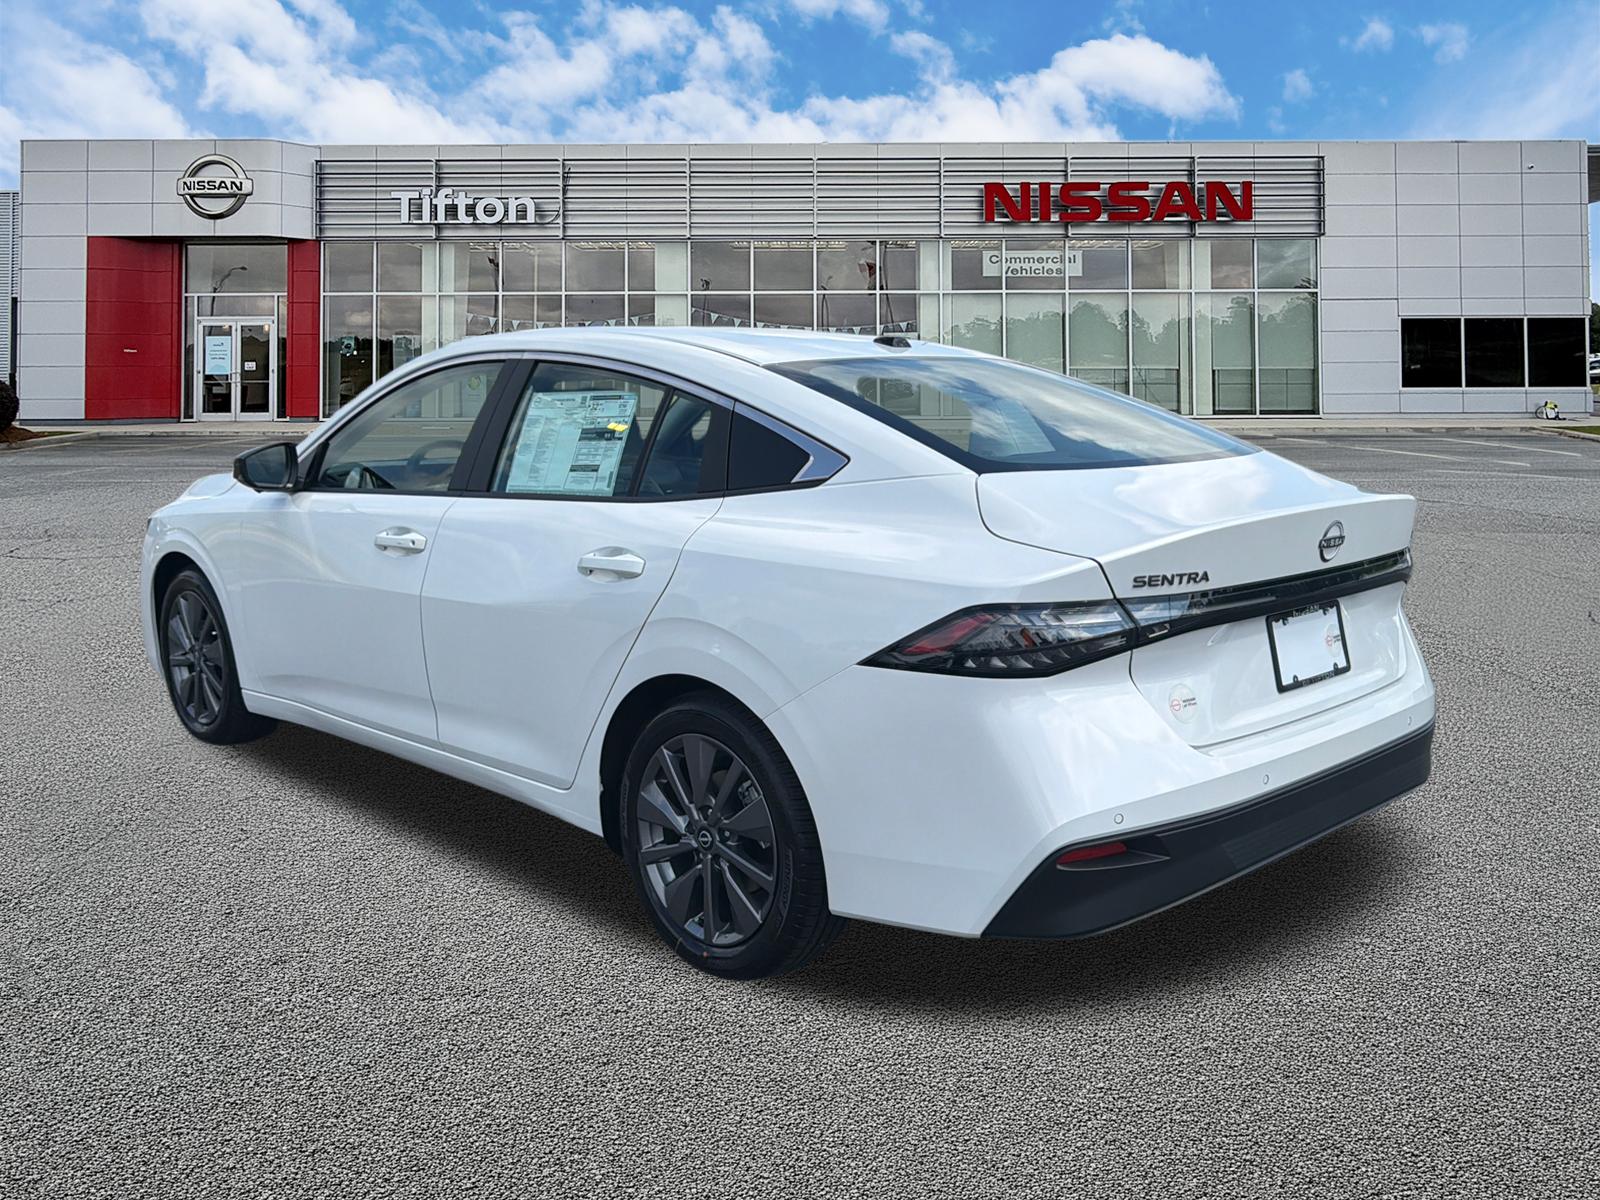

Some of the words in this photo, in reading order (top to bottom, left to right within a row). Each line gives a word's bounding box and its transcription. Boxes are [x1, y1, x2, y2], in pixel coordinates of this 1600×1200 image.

[183, 180, 243, 192] NISSAN
[391, 187, 536, 224] Tifton
[984, 180, 1253, 222] NISSAN
[1132, 570, 1210, 589] SENTRA
